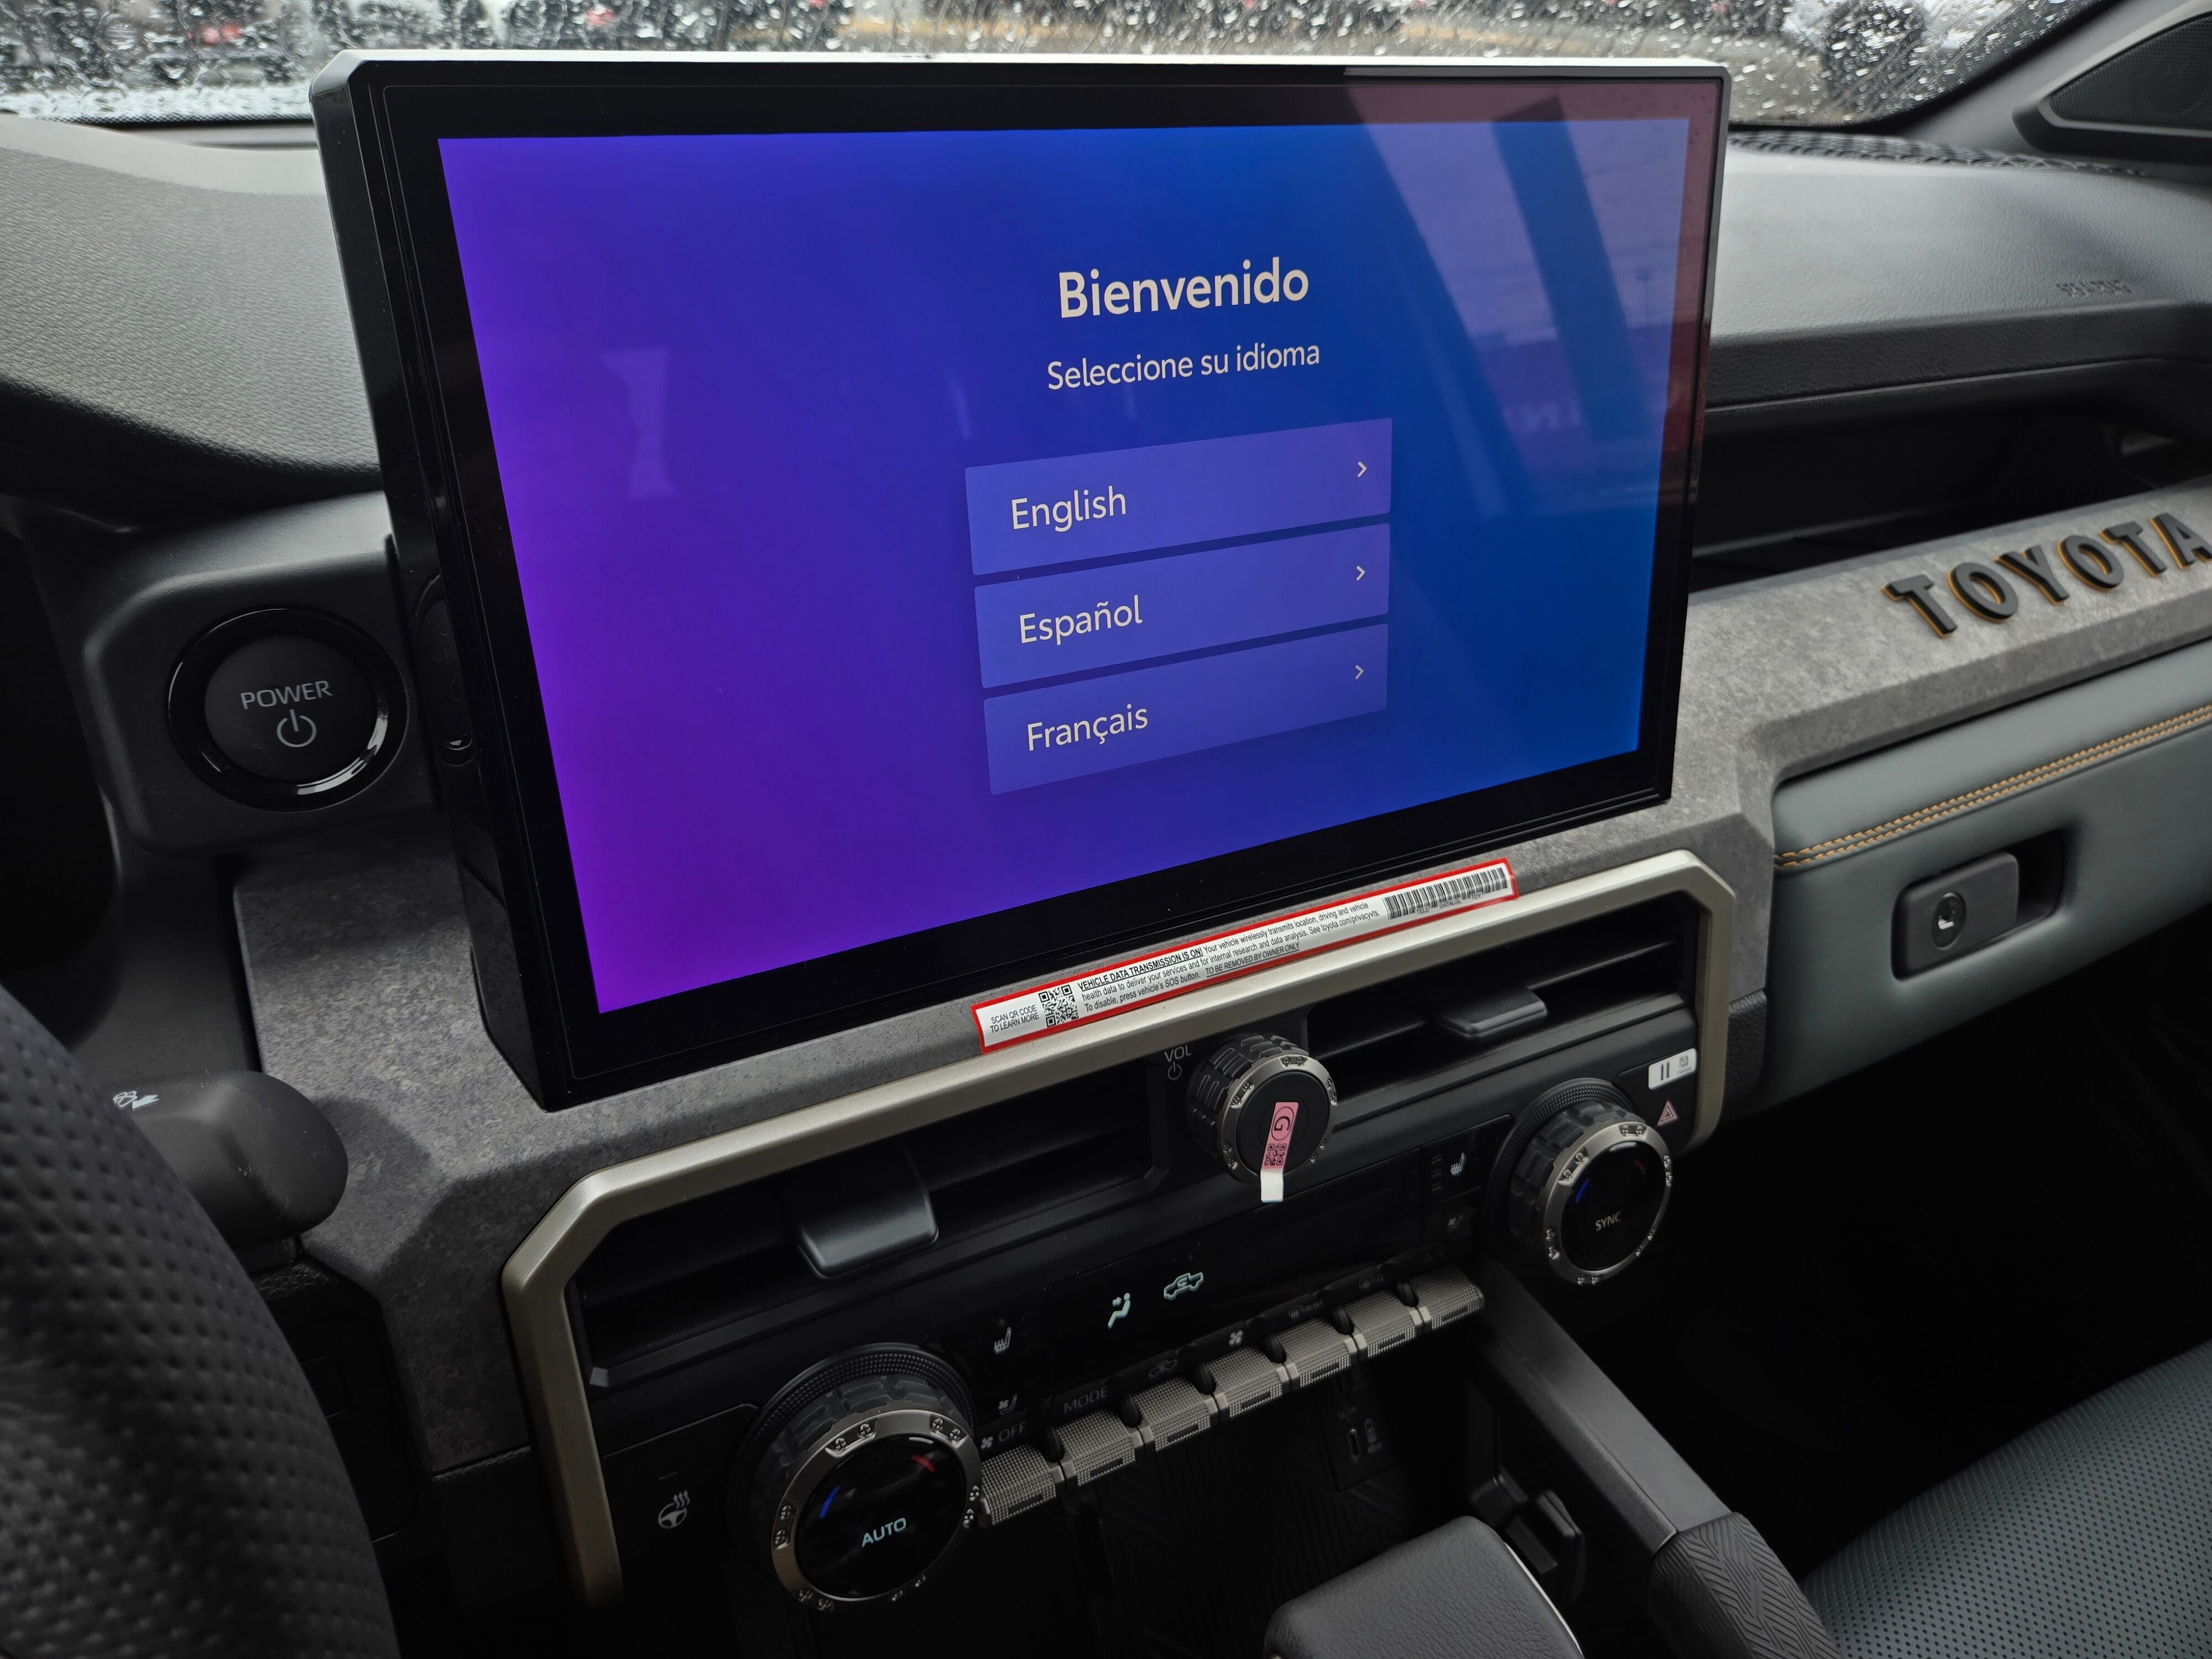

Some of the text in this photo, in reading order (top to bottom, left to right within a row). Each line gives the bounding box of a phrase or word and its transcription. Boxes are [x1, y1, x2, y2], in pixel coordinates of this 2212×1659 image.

[1059, 257, 1309, 319] Bienvenido
[1048, 342, 1320, 390] Seleccione su idioma
[1011, 485, 1126, 533] English
[1881, 512, 2212, 638] TOYOTA
[1019, 594, 1142, 646] Español
[240, 680, 333, 710] POWER
[1027, 703, 1148, 752] Français
[1078, 901, 1369, 990] VEHICLE DATA TRANSMISSION IS ON! Your vehicle wirelessly transmits location, driving and vehicle
[1082, 990, 1102, 1001] health
[1103, 985, 1117, 995] data
[1126, 977, 1146, 988] deliver
[1147, 972, 1161, 983] your
[1162, 965, 1187, 977] services
[1188, 961, 1200, 969] and
[1200, 958, 1209, 966] for
[1209, 950, 1232, 963] internal
[1232, 943, 1258, 957] research
[1259, 939, 1270, 948] and
[1270, 936, 1284, 946] data
[1284, 930, 1308, 942] analysis.
[1308, 926, 1321, 935] See
[1084, 941, 1300, 1012] To disable, press vehicle's SOS button. TO BE REMOVED BY OWNER ONLY
[989, 1012, 1040, 1033] TO LEARN MORE
[990, 1004, 1038, 1024] SCAN QR CODE
[1164, 1045, 1191, 1062] VOL
[1274, 1115, 1291, 1131] G
[1595, 1211, 1621, 1232] SYNC
[1063, 1386, 1108, 1414] MODE
[998, 1420, 1027, 1442] OFF
[862, 1517, 906, 1548] AUTO
